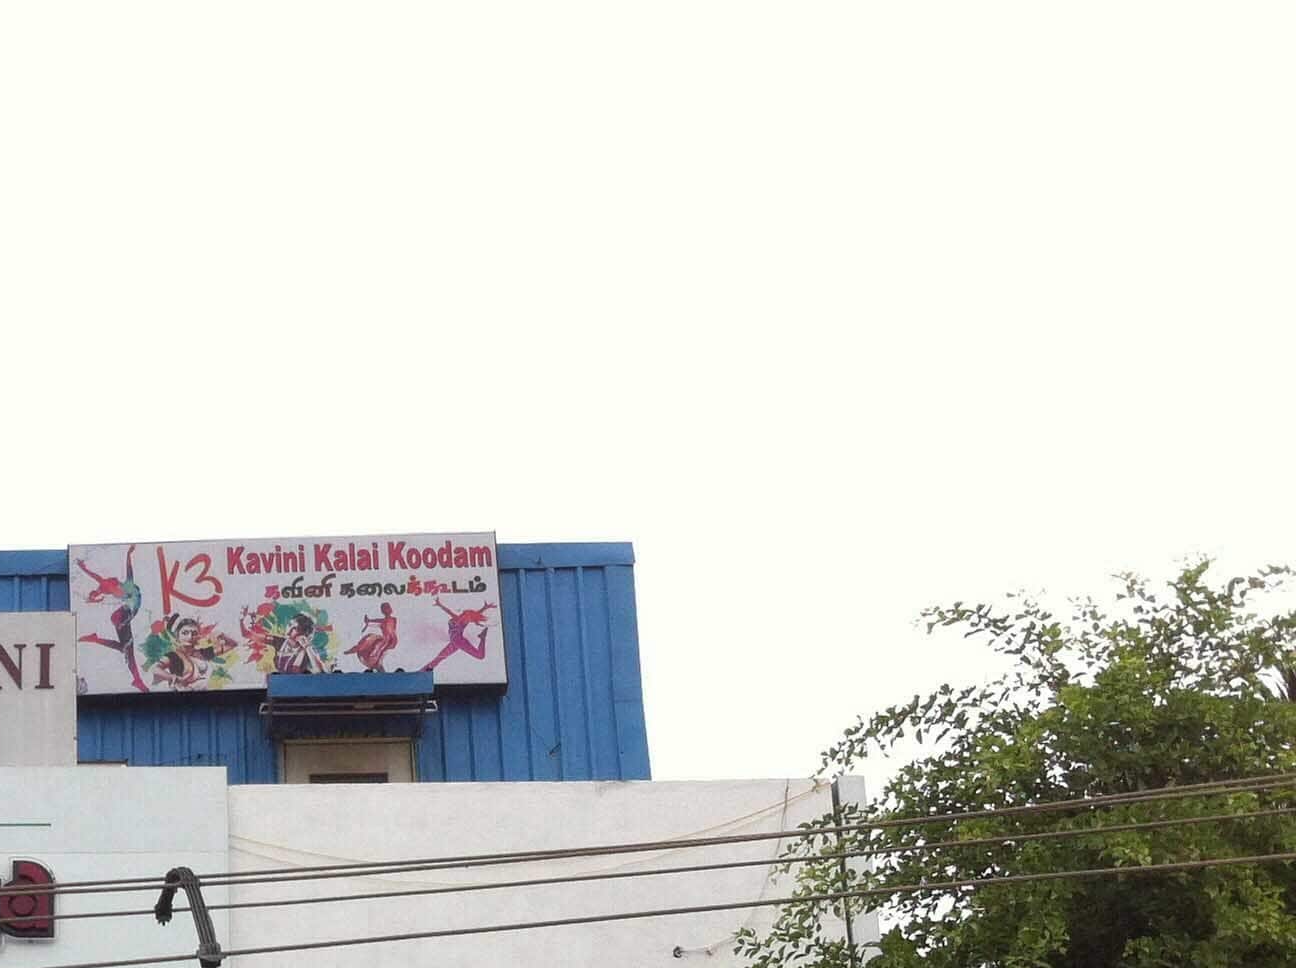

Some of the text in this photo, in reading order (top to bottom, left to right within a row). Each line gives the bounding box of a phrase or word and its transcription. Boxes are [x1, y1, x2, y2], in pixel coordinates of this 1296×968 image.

[226, 540, 493, 575] Kavini Kalai Koodam
[157, 546, 223, 615] K3
[264, 573, 336, 599] கவினி
